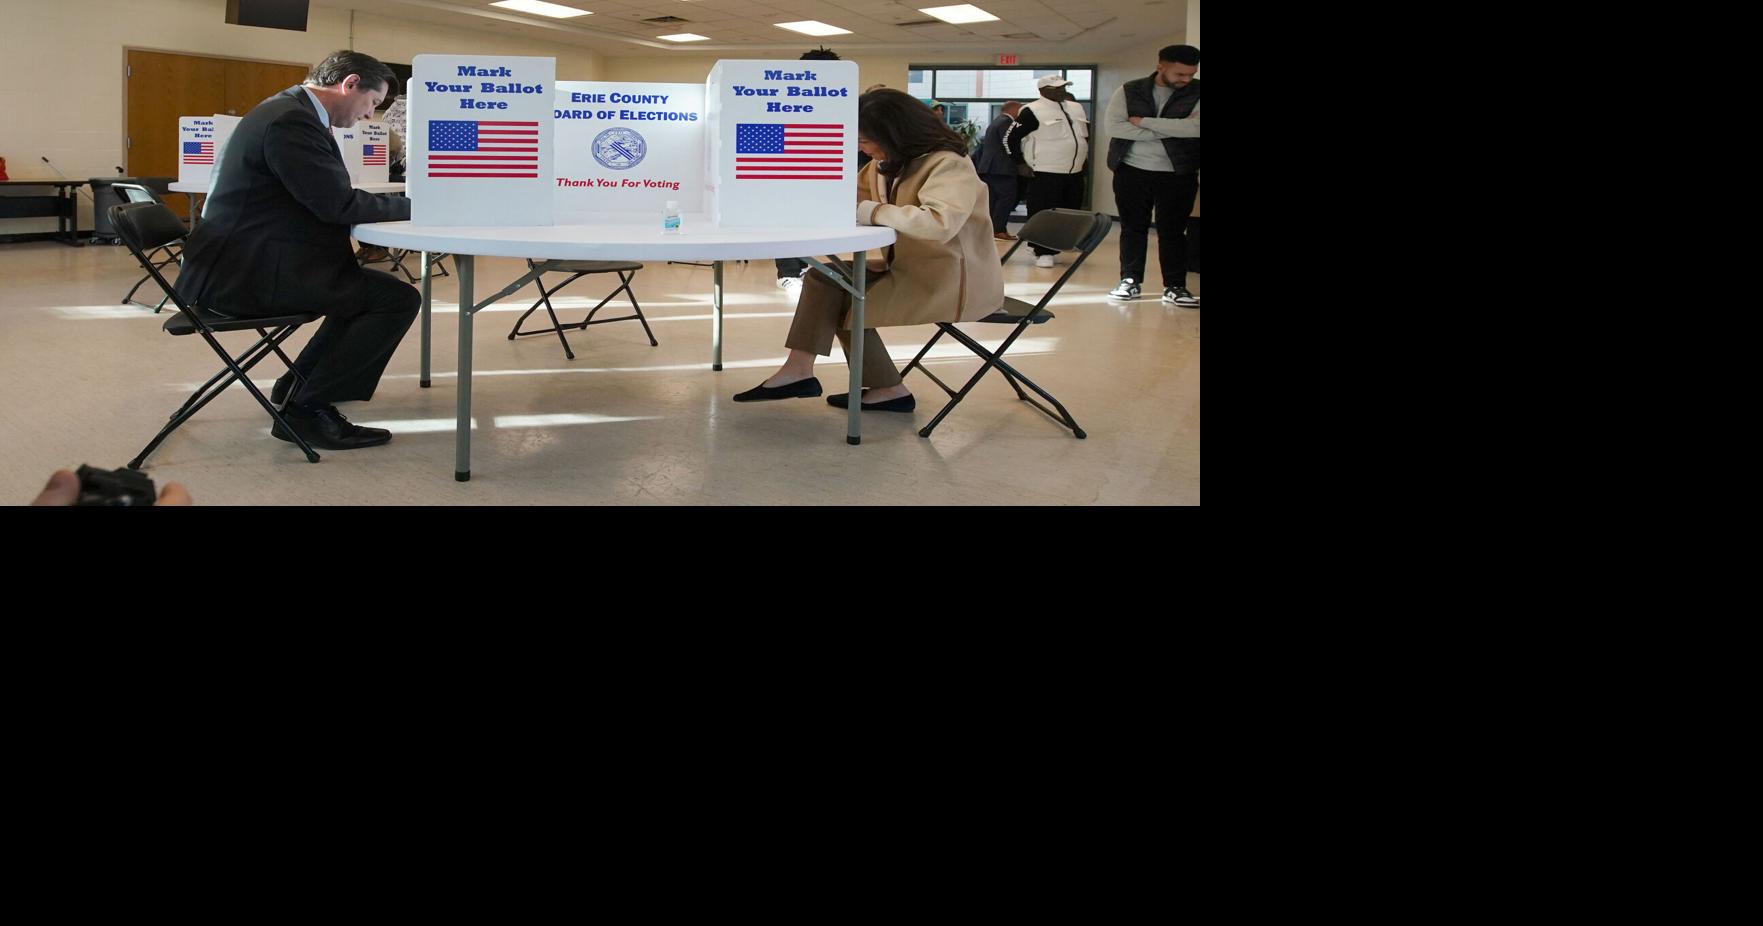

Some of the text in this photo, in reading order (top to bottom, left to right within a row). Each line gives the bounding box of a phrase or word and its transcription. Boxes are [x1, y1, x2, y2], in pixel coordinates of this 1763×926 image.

[1000, 55, 1016, 64] EXIT
[457, 65, 512, 77] Mark
[764, 70, 817, 80] Mark
[425, 81, 543, 94] Your Ballot
[732, 85, 848, 97] Your Ballot
[459, 98, 508, 110] Here
[571, 92, 669, 105] ERIE COUNTY
[766, 102, 814, 113] Here
[554, 109, 698, 122] OARD OF ELECTIONS
[556, 177, 680, 191] Thank You For Voting
